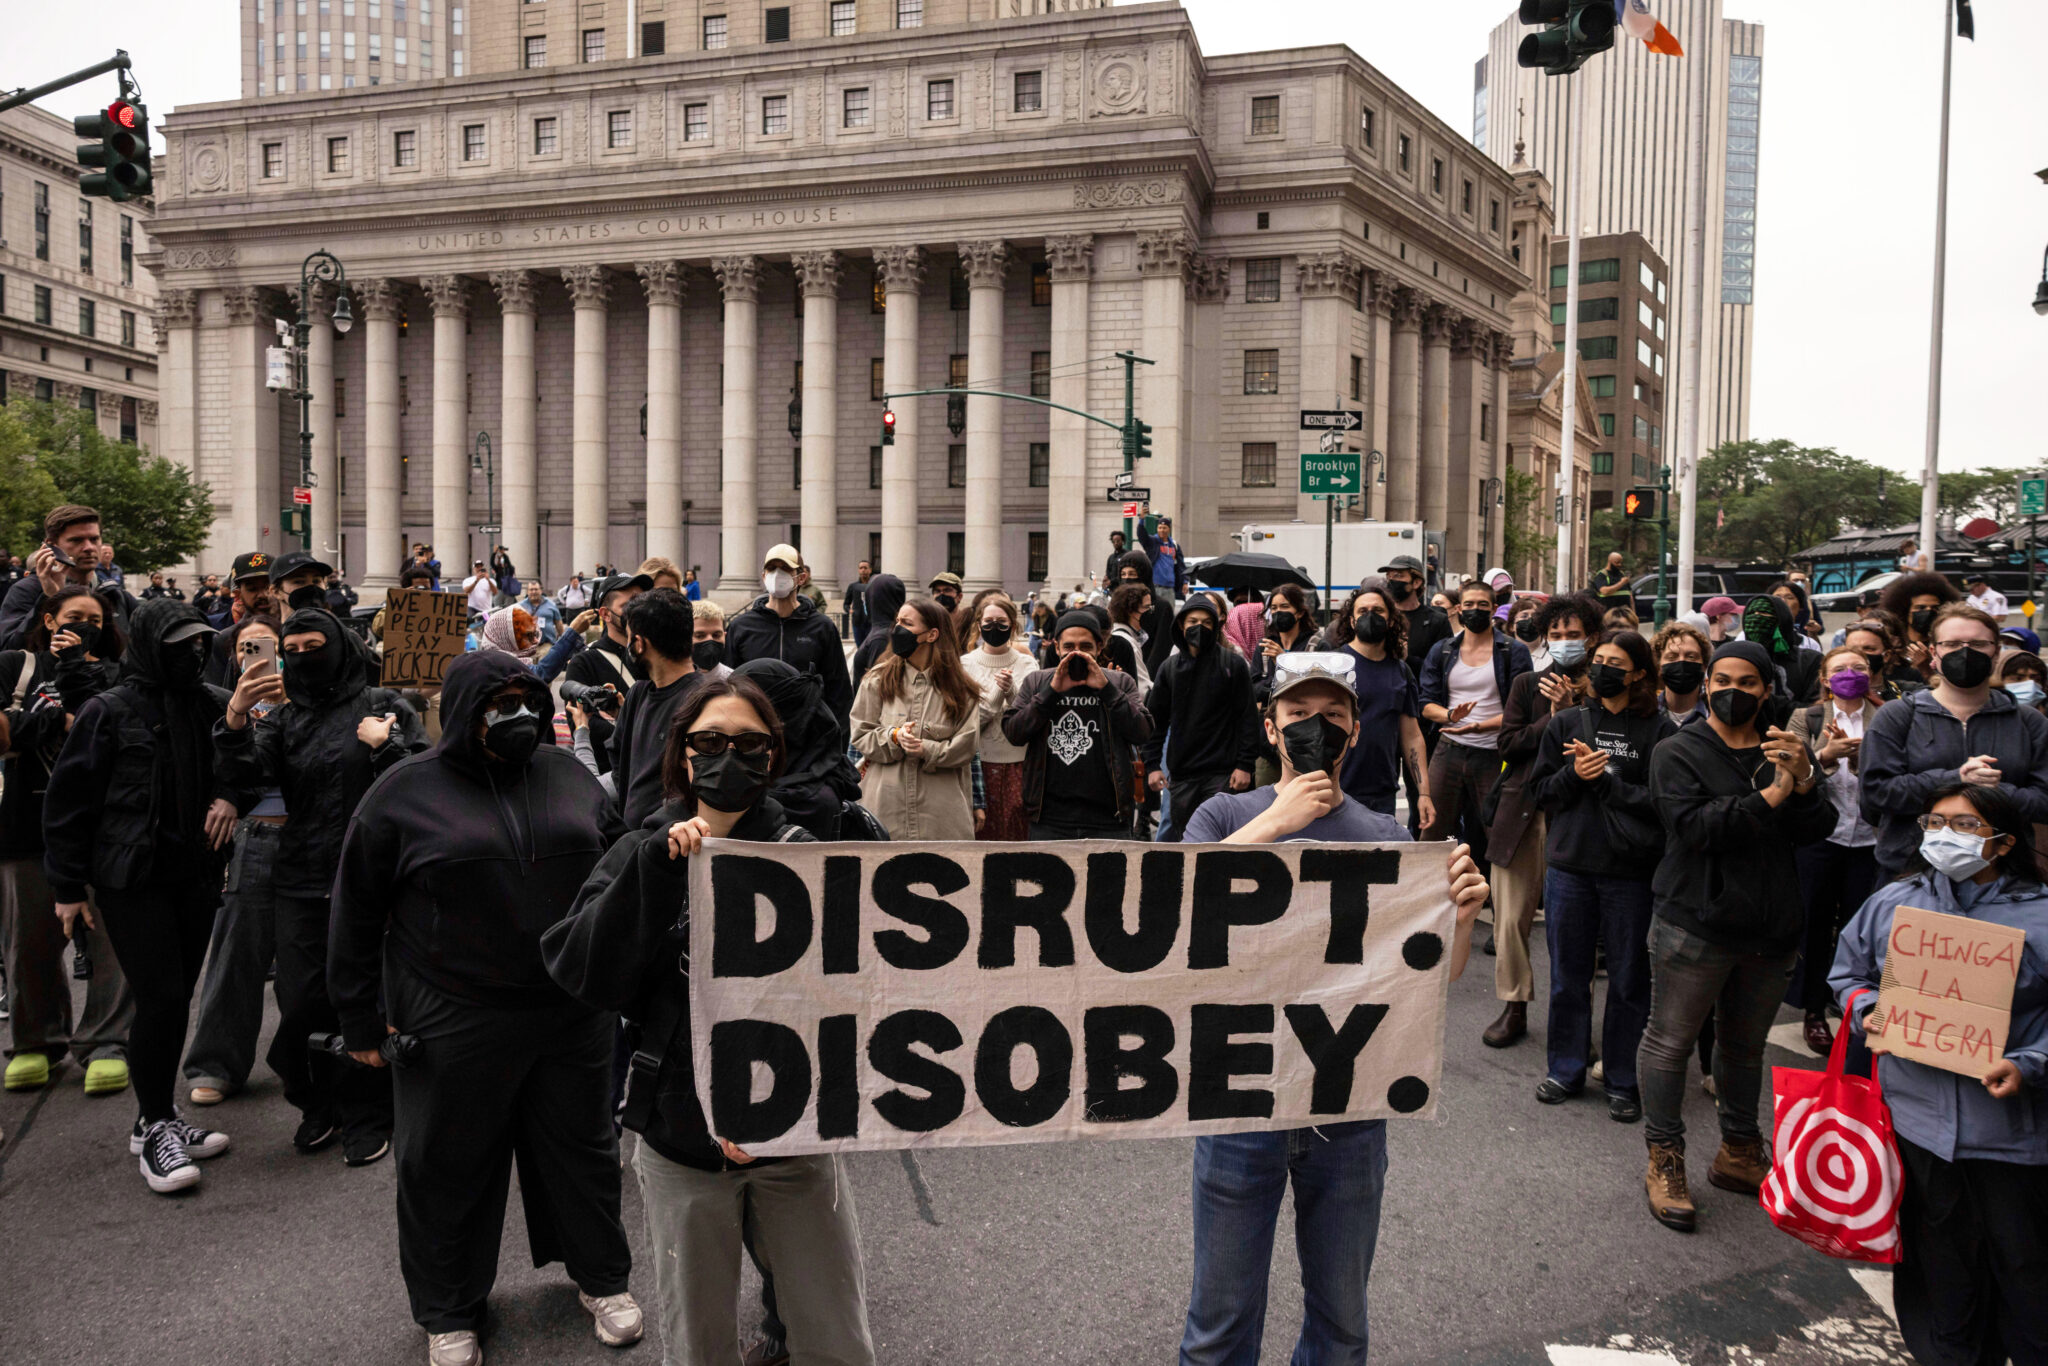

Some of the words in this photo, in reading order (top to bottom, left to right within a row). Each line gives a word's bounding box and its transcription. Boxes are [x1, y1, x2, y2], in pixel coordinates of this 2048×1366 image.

[418, 231, 504, 250] UNITED
[532, 223, 611, 243] STATES
[636, 214, 727, 235] COURT
[752, 207, 838, 227] HOUSE
[1309, 416, 1327, 425] ONE
[1335, 416, 1353, 425] WAY
[1305, 460, 1356, 474] Brooklyn
[1308, 475, 1321, 486] Br
[387, 591, 421, 612] WE
[430, 593, 469, 617] THE
[391, 613, 467, 637] PEOPLE
[404, 634, 442, 650] SAY
[382, 647, 422, 681] FUCK
[422, 652, 457, 681] IC
[711, 849, 1444, 978] DISRUPT.
[1892, 923, 2016, 978] CHINGA
[1918, 968, 1963, 1001] LA
[1880, 1005, 1994, 1064] MIGRA
[710, 1004, 1430, 1144] DISOBEY.
